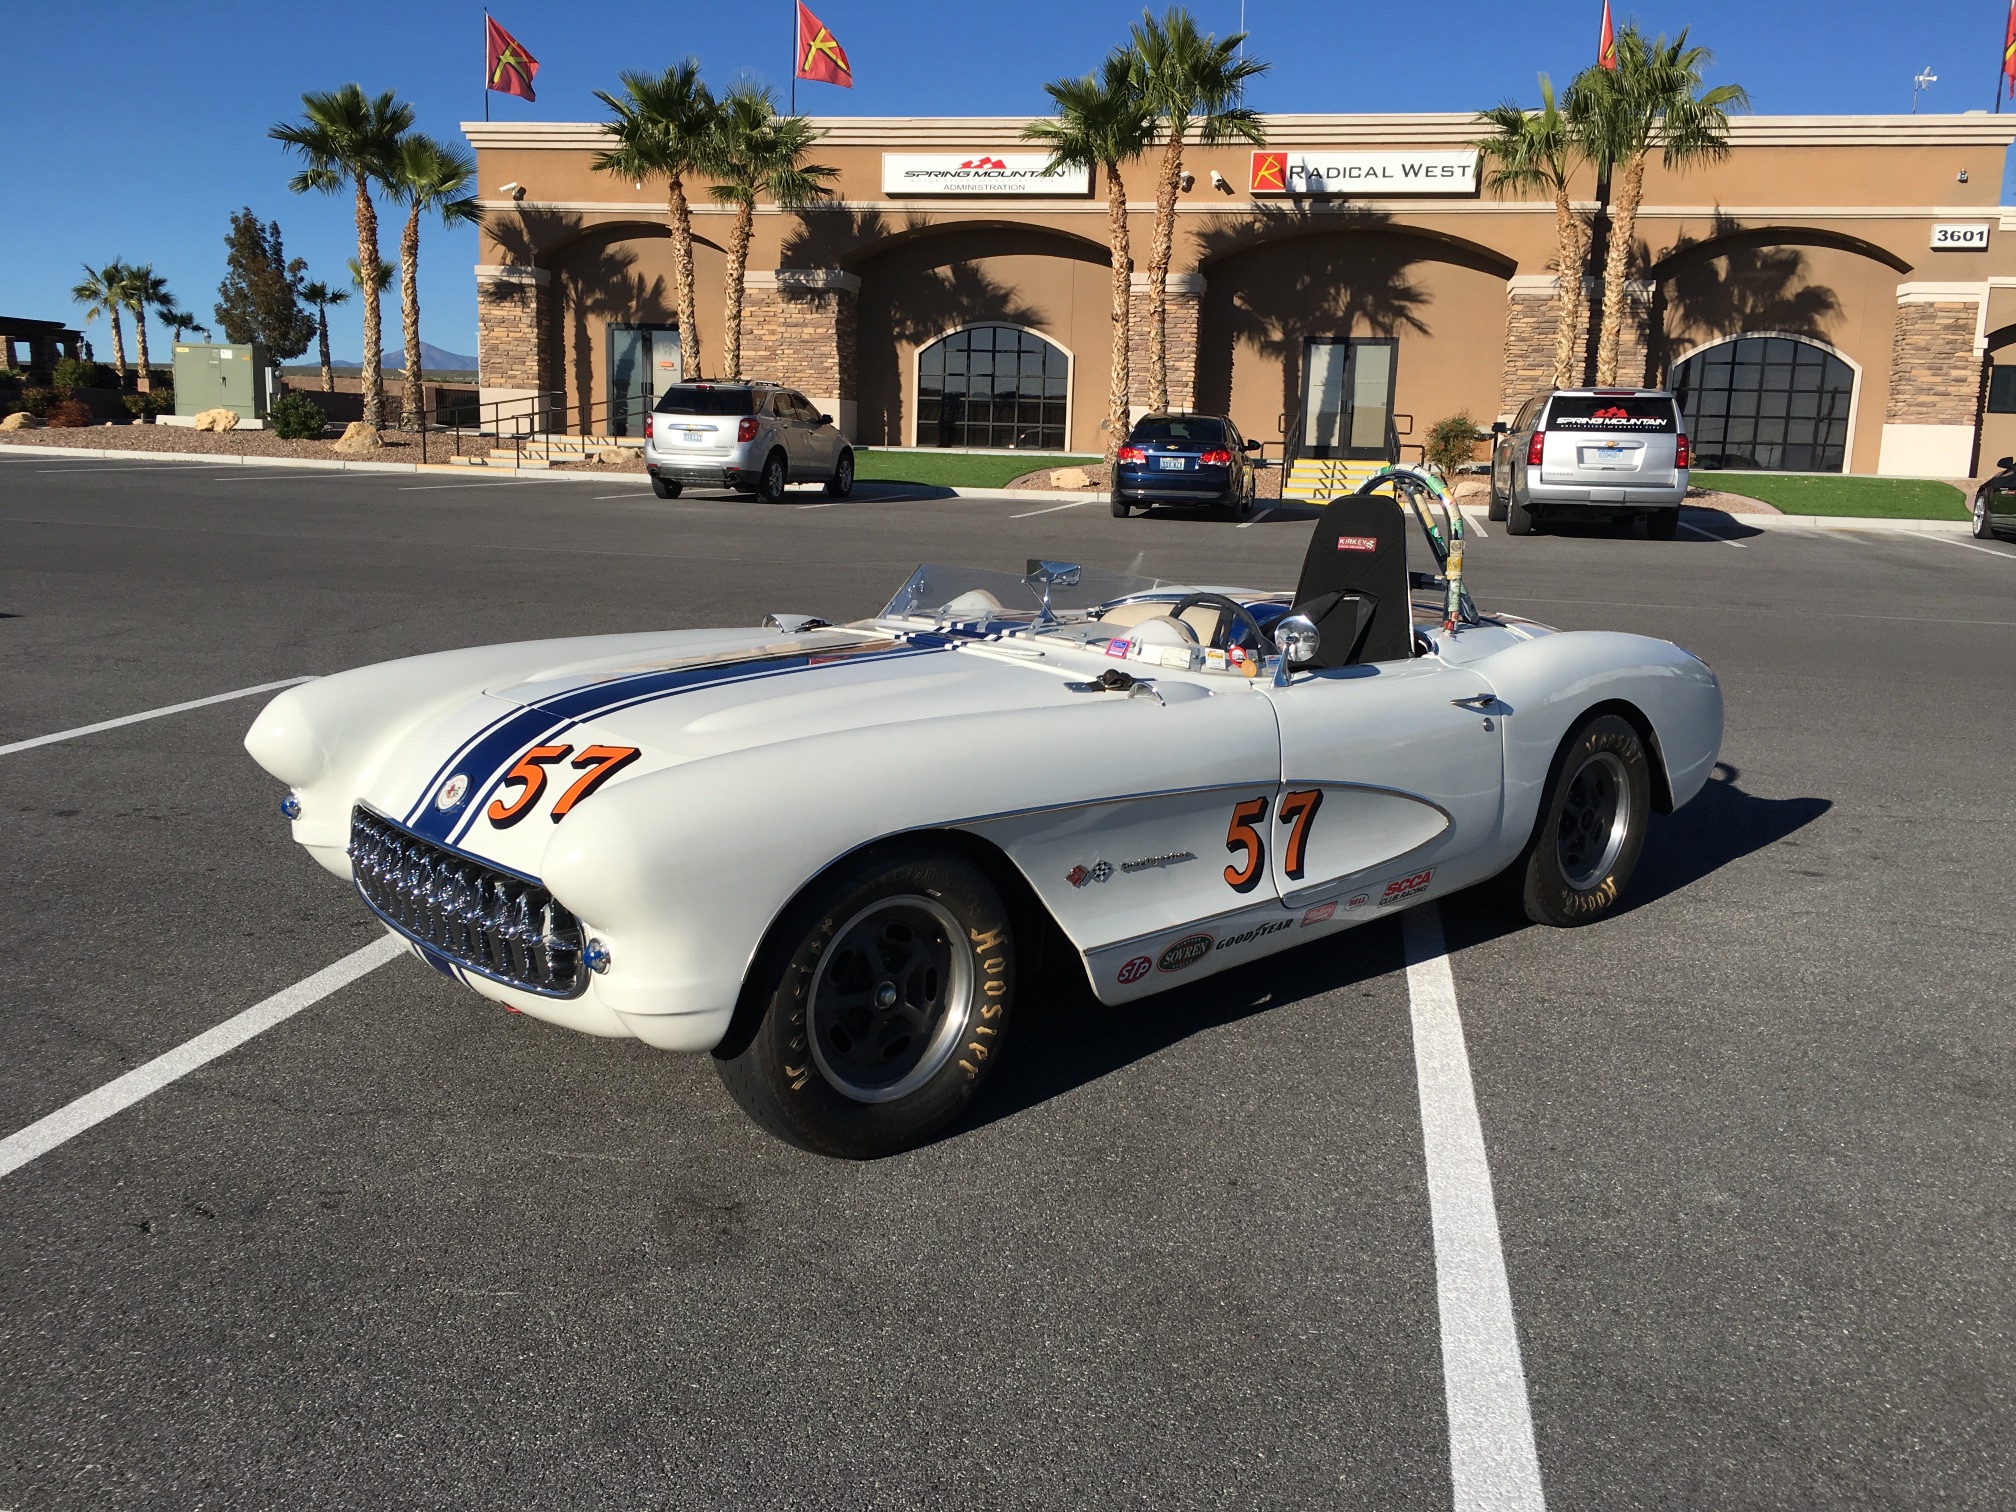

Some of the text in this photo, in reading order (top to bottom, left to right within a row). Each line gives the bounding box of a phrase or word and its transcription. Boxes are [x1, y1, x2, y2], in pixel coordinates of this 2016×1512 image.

[904, 170, 971, 178] SPRING
[1289, 163, 1471, 180] RADICAL WEST
[1937, 229, 1985, 242] 3601
[487, 744, 642, 830] 57
[1223, 788, 1324, 894] 57
[1384, 871, 1431, 896] SCCA
[1349, 897, 1366, 907] BELL
[1380, 885, 1427, 906] CLUB RACING
[1216, 918, 1294, 950] GOODYEAR
[1163, 940, 1209, 966] SOVREN
[1119, 958, 1149, 981] STP
